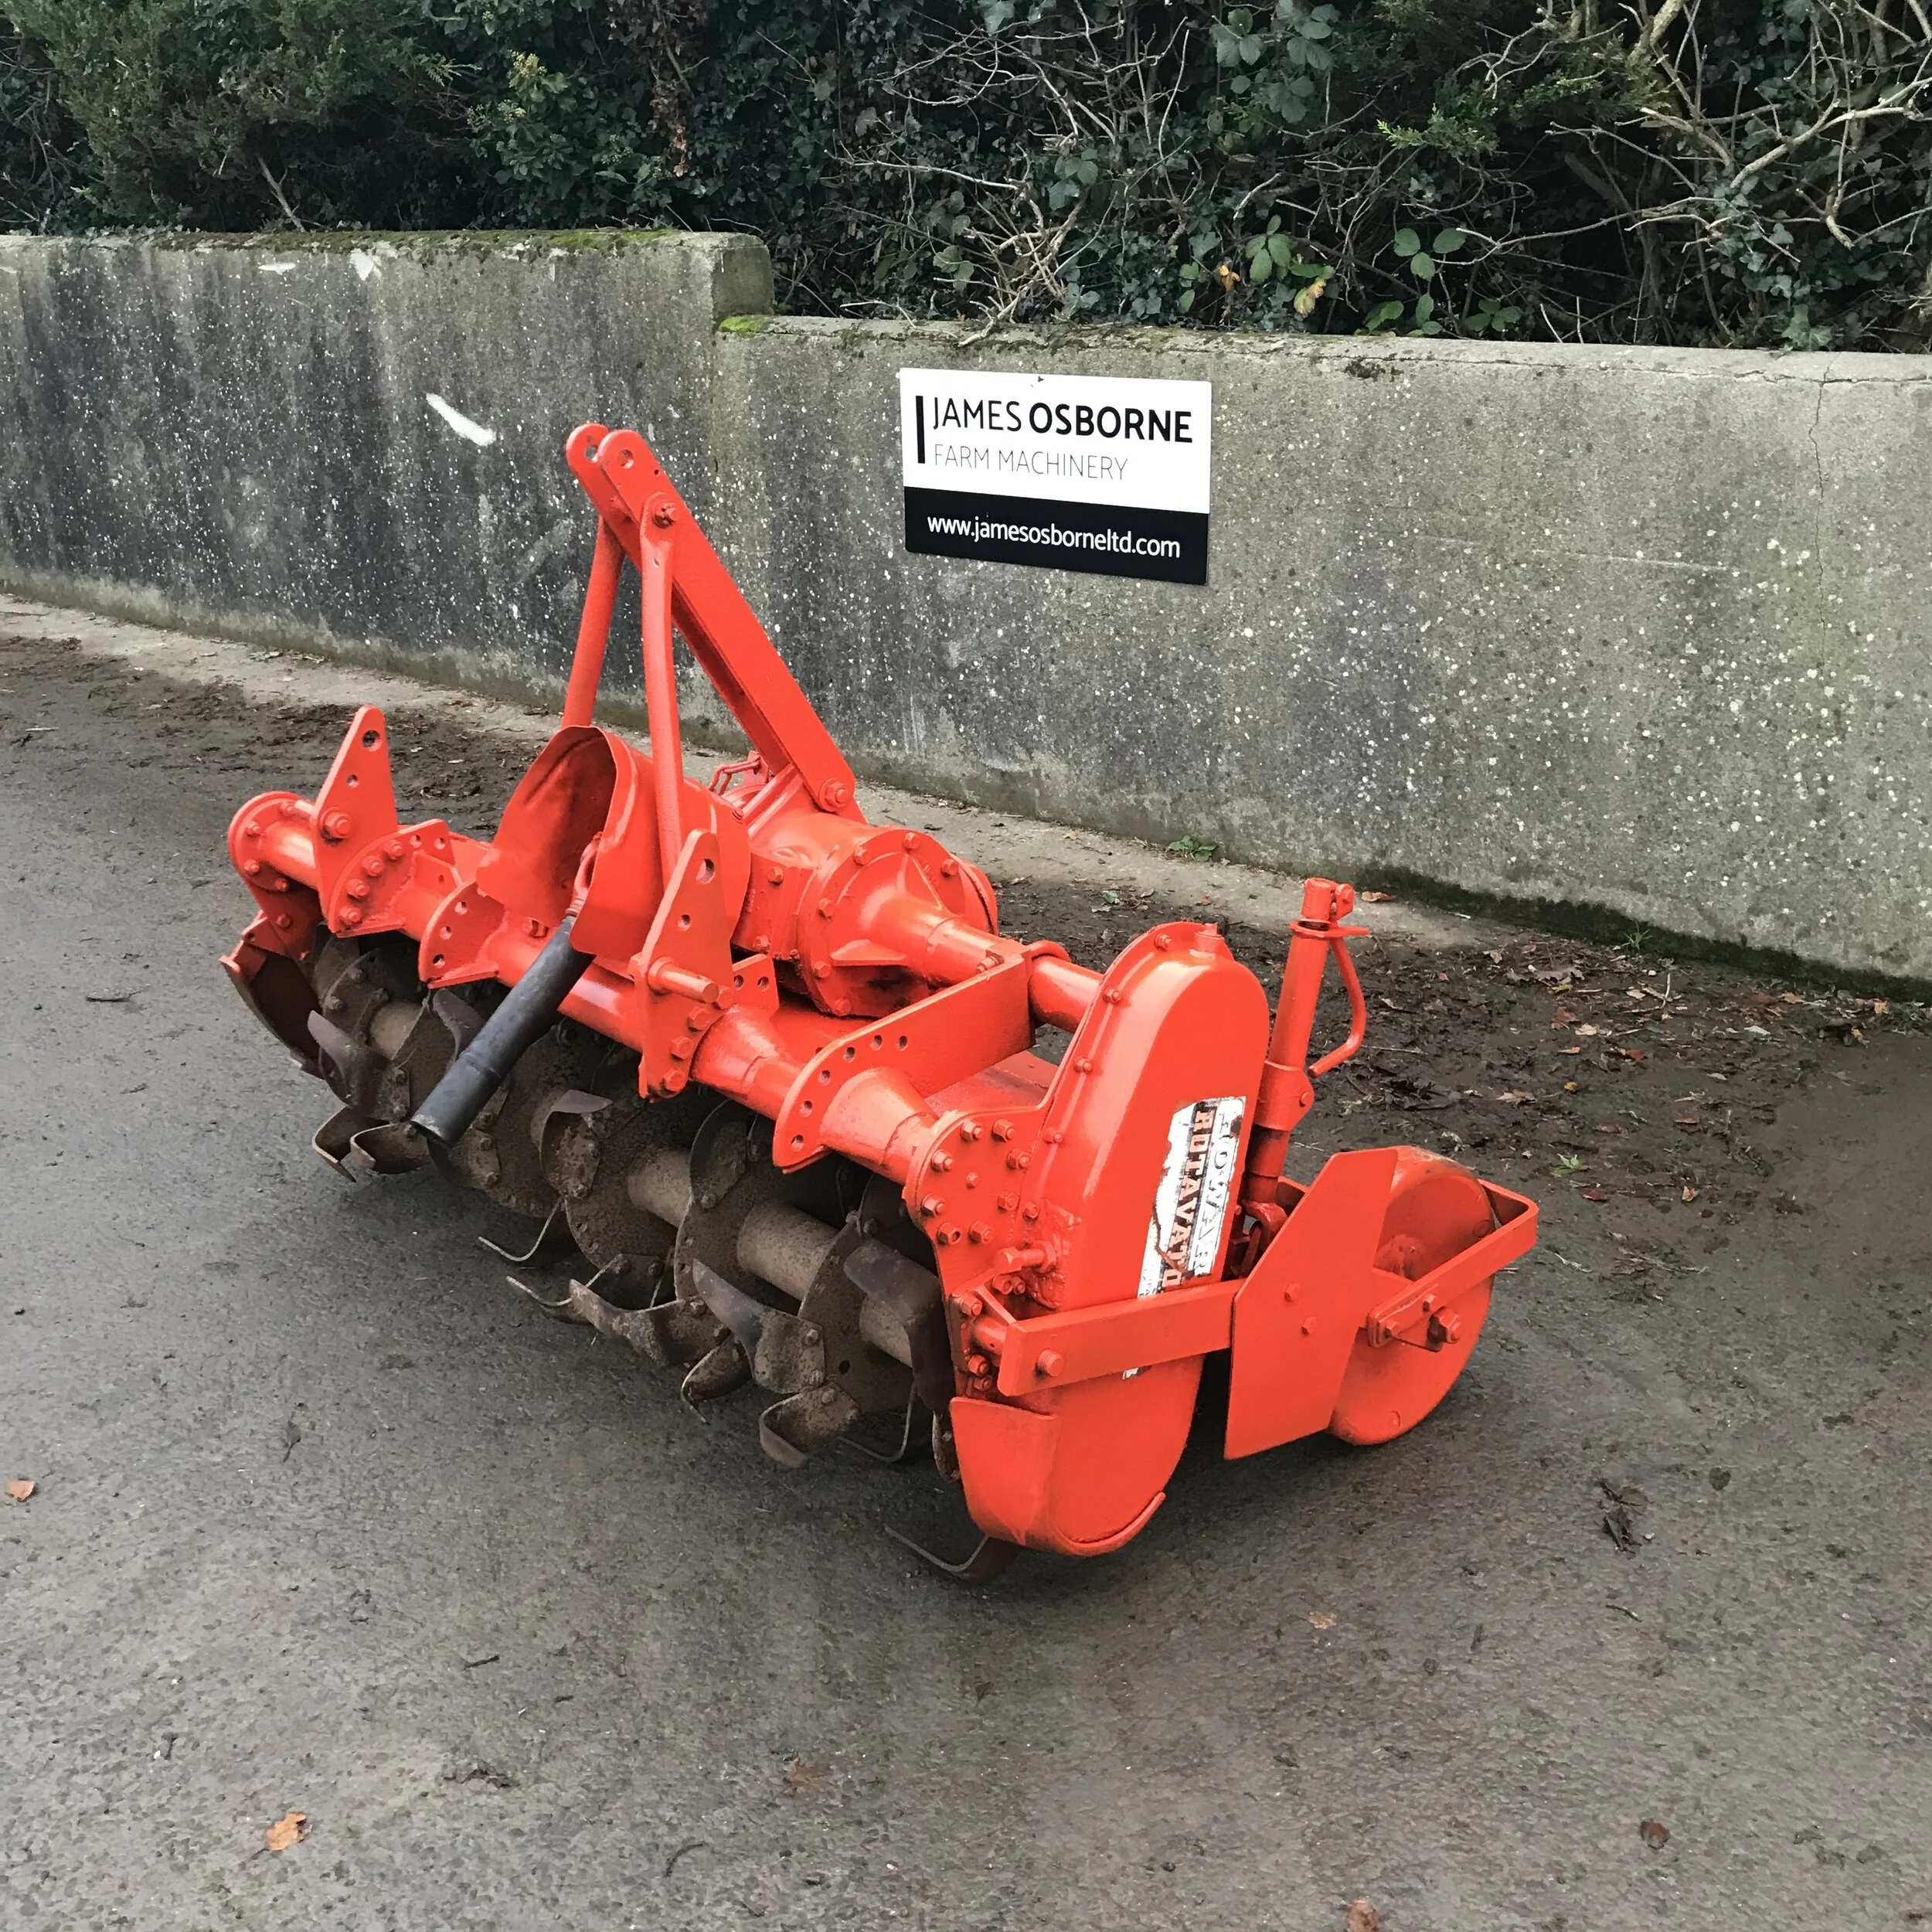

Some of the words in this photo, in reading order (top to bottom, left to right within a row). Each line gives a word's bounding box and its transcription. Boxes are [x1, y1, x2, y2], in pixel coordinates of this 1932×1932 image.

[933, 396, 1022, 432] JAMES
[1029, 402, 1193, 443] OSBORNE
[934, 444, 990, 469] FARM
[998, 450, 1128, 481] MACHINERY
[927, 515, 1181, 559] www.jamesosborneltd.com
[1162, 1110, 1216, 1289] ROTAVATO
